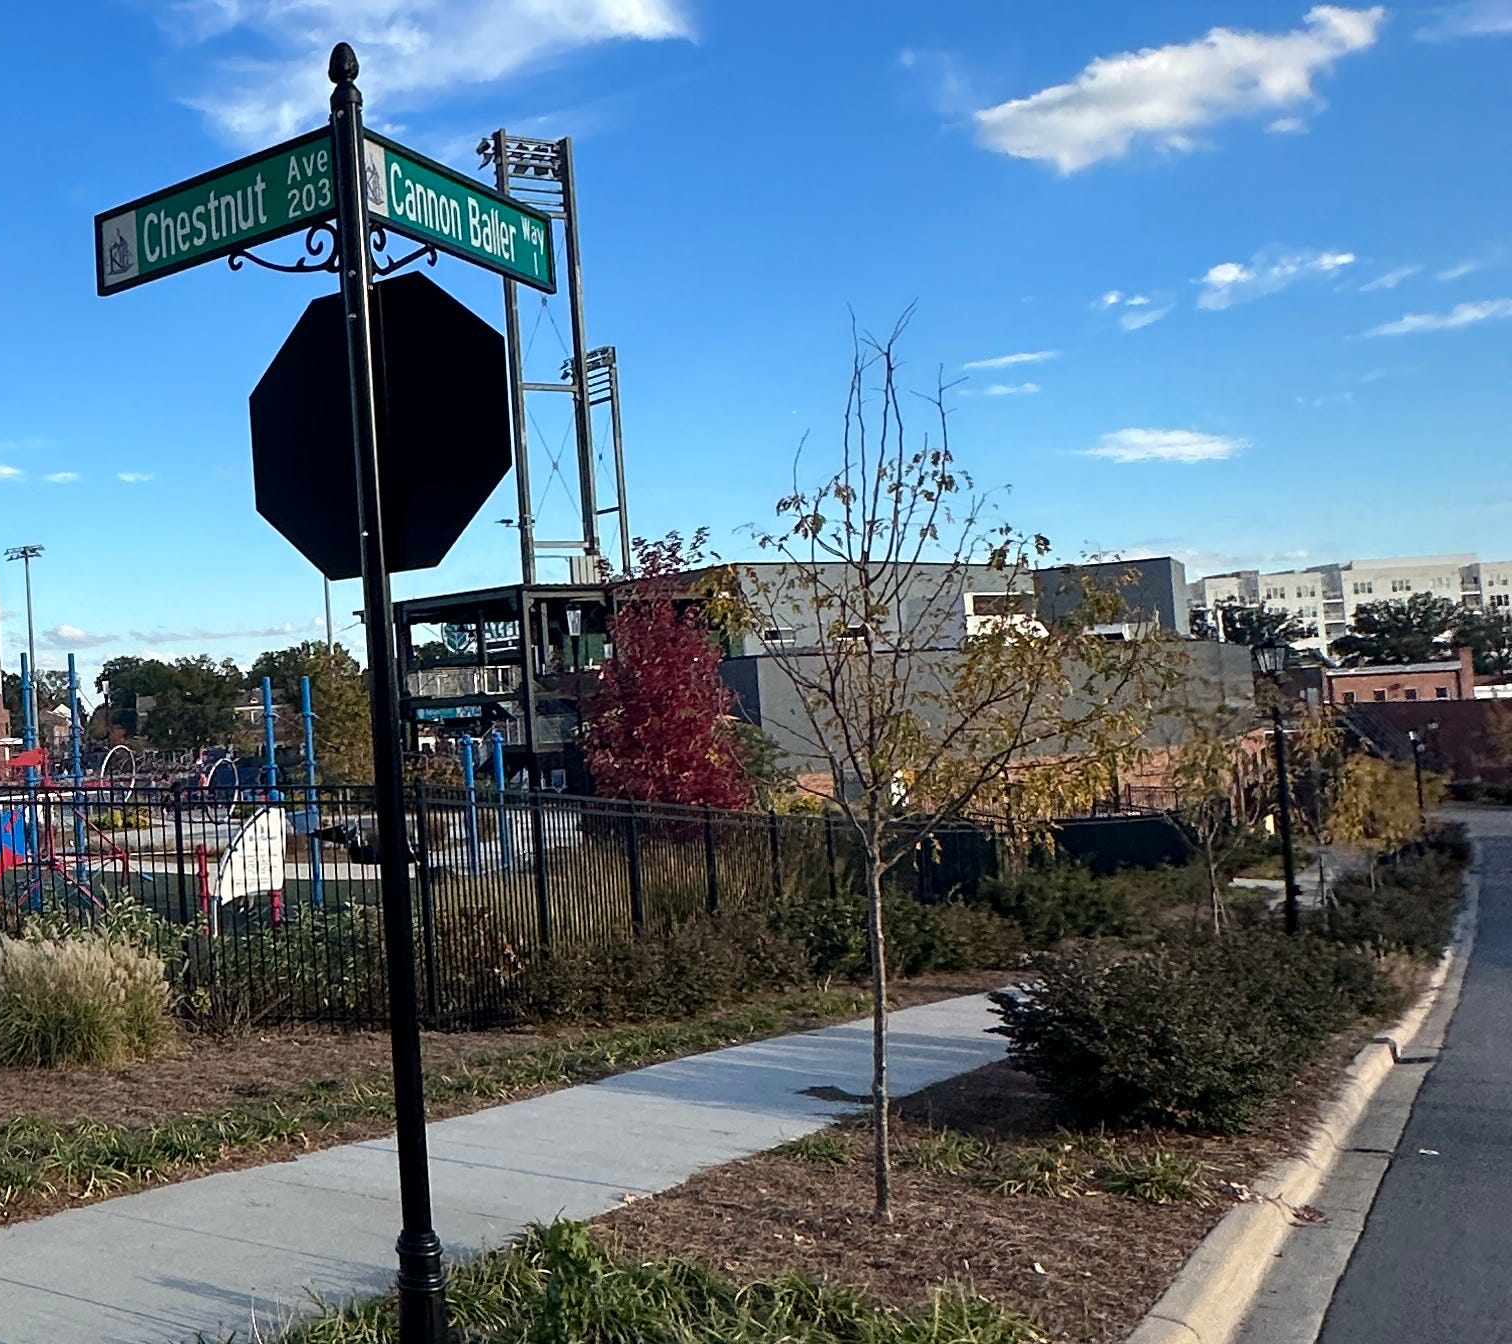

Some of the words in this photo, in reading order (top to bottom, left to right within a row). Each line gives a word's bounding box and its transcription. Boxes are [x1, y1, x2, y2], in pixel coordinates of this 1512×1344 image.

[143, 172, 268, 263] Chestnut
[288, 149, 328, 185] Ave
[287, 178, 332, 219] 203
[390, 161, 463, 241] Cannon
[467, 196, 517, 263] Baller
[520, 215, 545, 256] Way
[533, 251, 539, 276] 1
